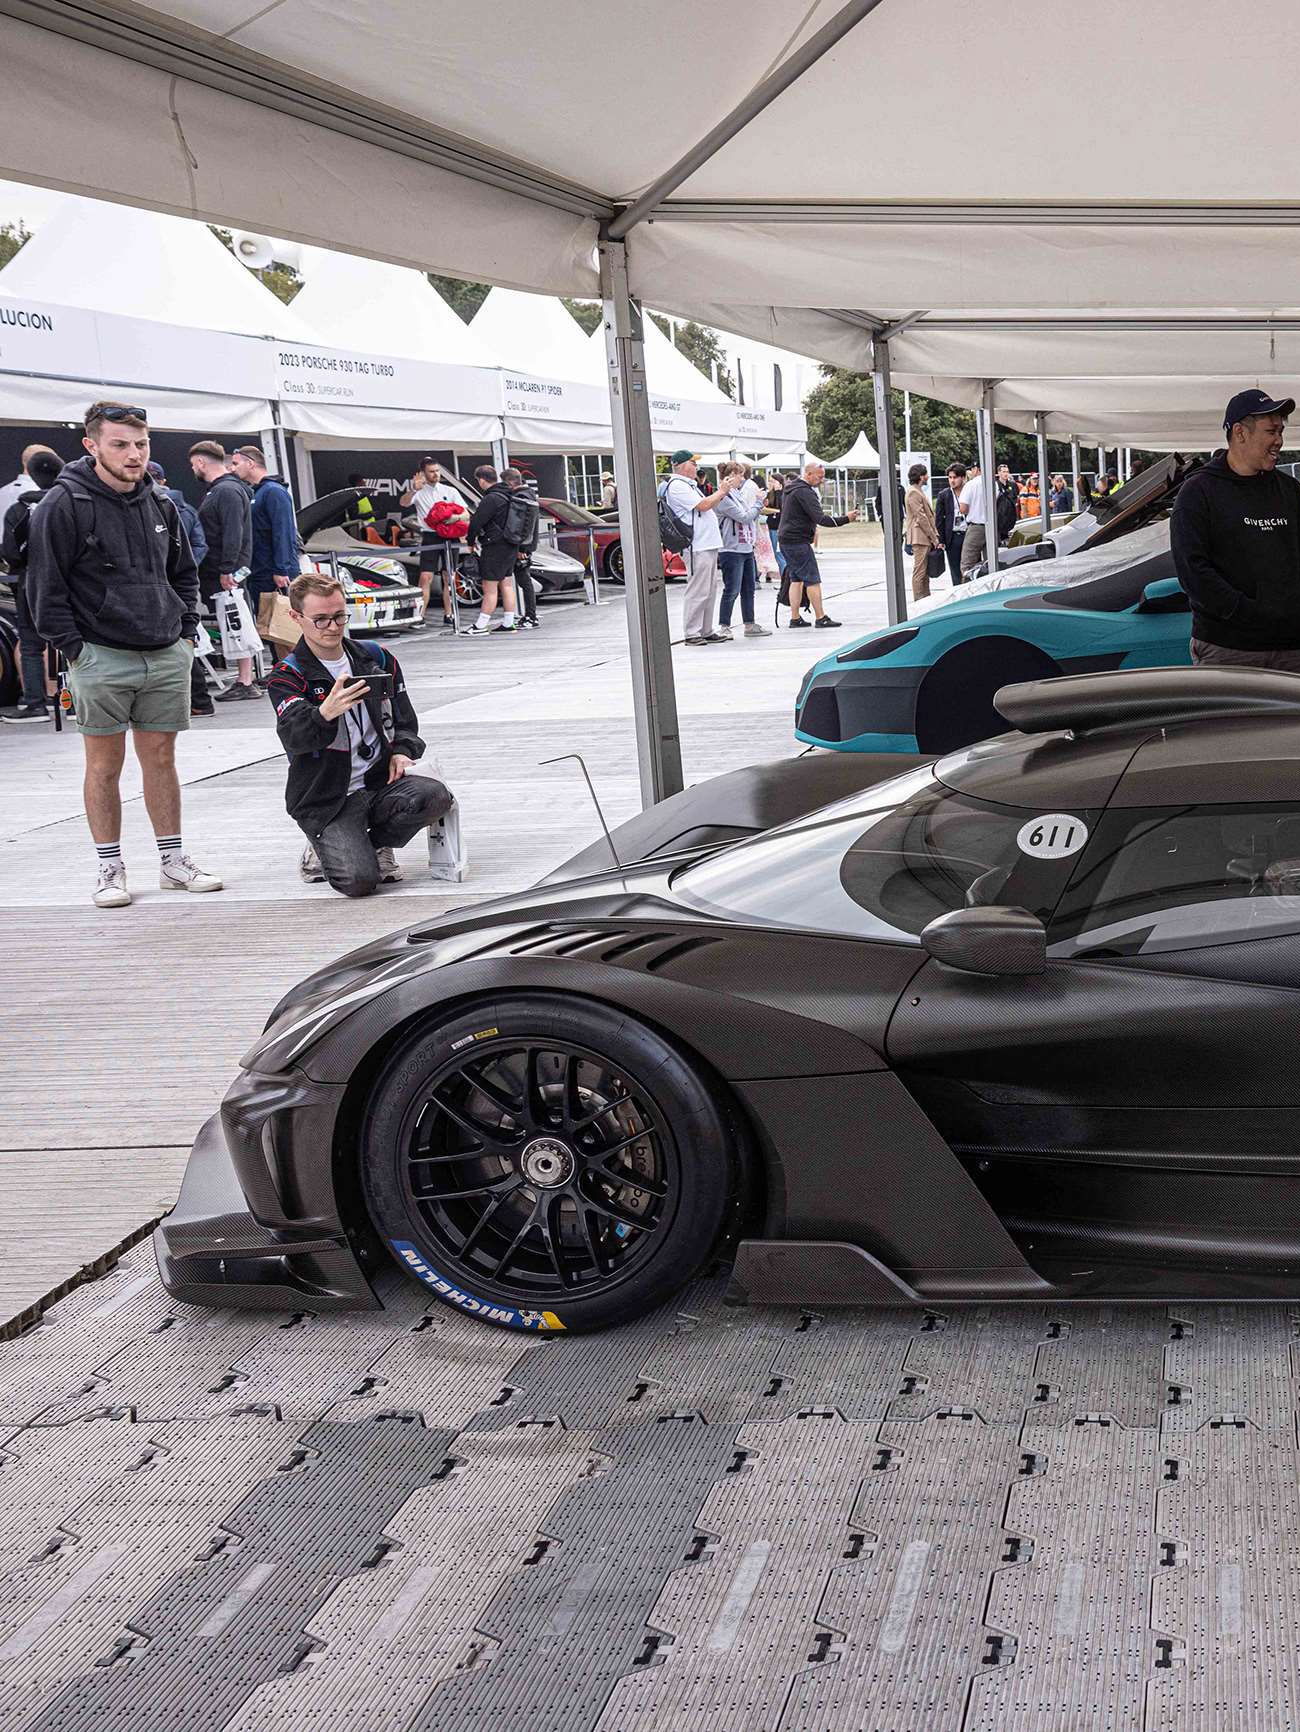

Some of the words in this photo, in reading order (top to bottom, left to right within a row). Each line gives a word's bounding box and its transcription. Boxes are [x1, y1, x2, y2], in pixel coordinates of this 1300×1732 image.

[0, 308, 53, 331] LUCION
[278, 353, 300, 367] 2023
[301, 355, 338, 371] PORSCHE
[339, 359, 353, 373] 930
[354, 361, 370, 375] TAG
[371, 363, 395, 377] TURBO
[283, 380, 304, 393] Class
[1243, 517, 1288, 527] GIVENCHY
[1029, 825, 1075, 848] 611
[400, 1249, 514, 1324] MICHELIN
